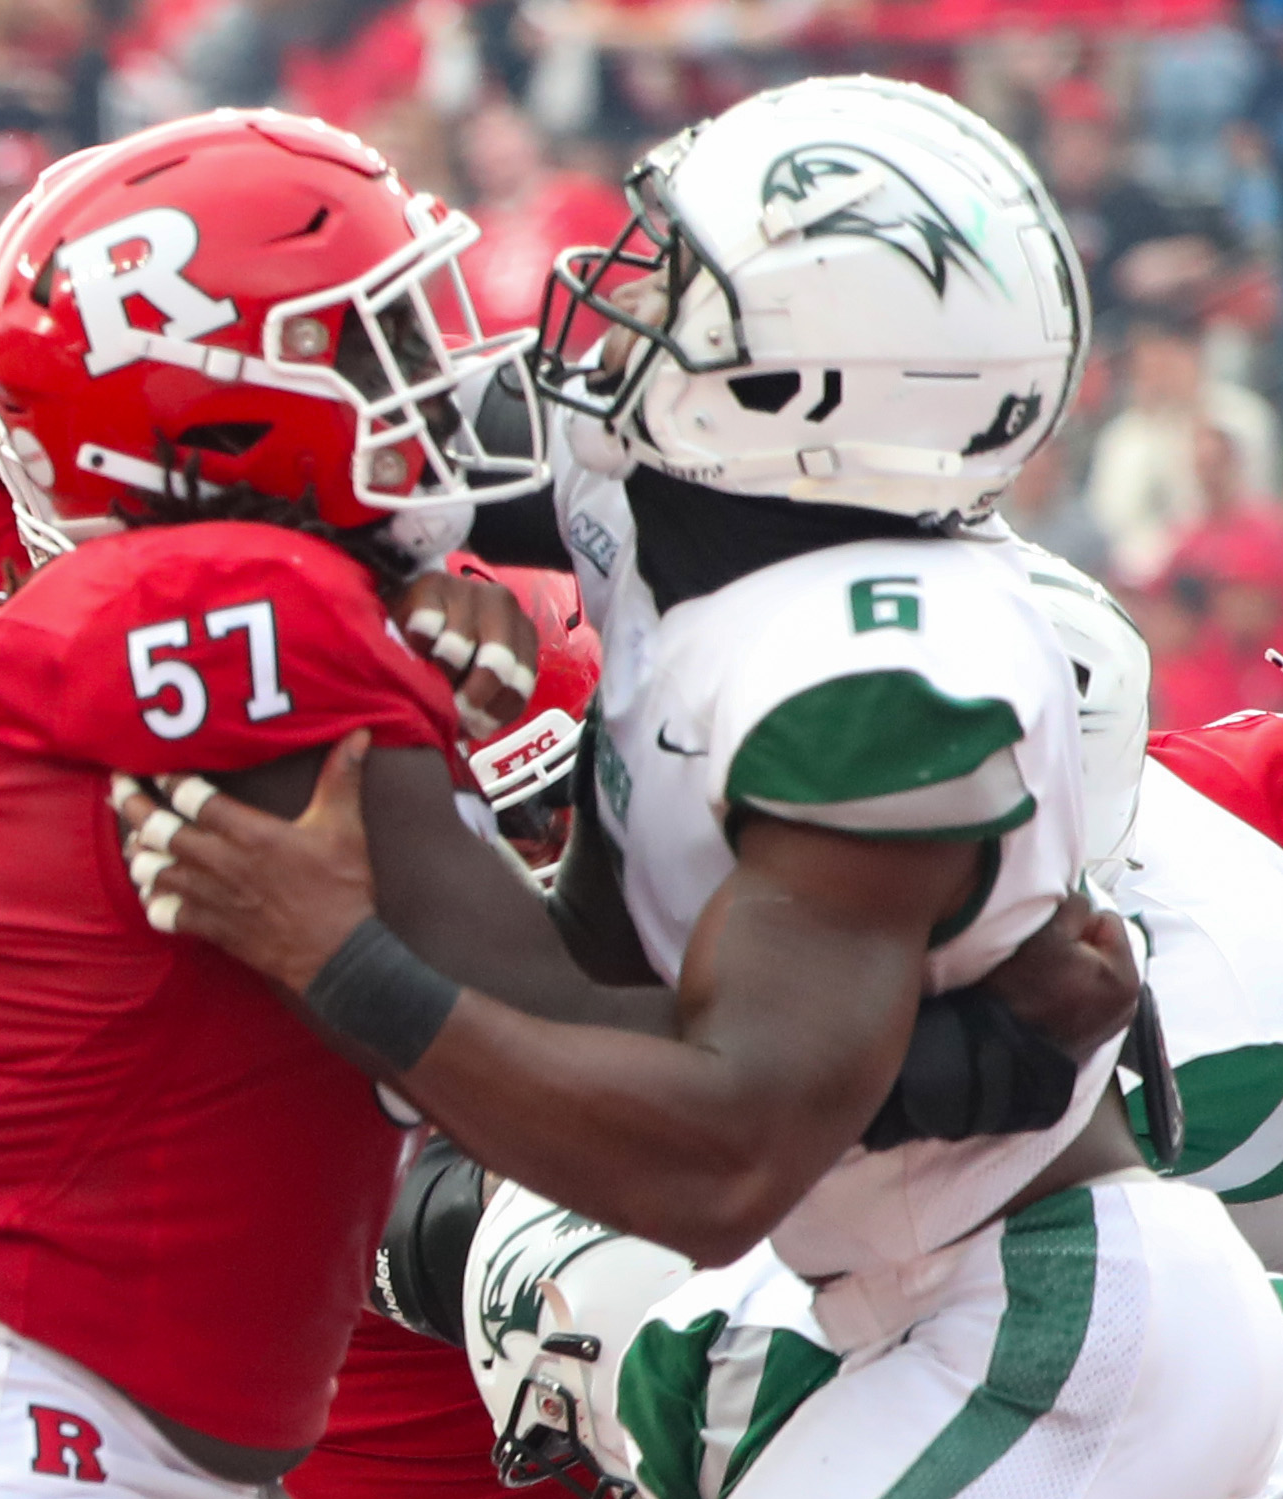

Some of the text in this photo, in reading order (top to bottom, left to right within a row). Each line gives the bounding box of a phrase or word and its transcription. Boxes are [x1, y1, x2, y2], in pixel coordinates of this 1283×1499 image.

[55, 206, 241, 380] R
[849, 576, 920, 634] 6
[127, 599, 292, 740] 57
[29, 1404, 109, 1482] R
